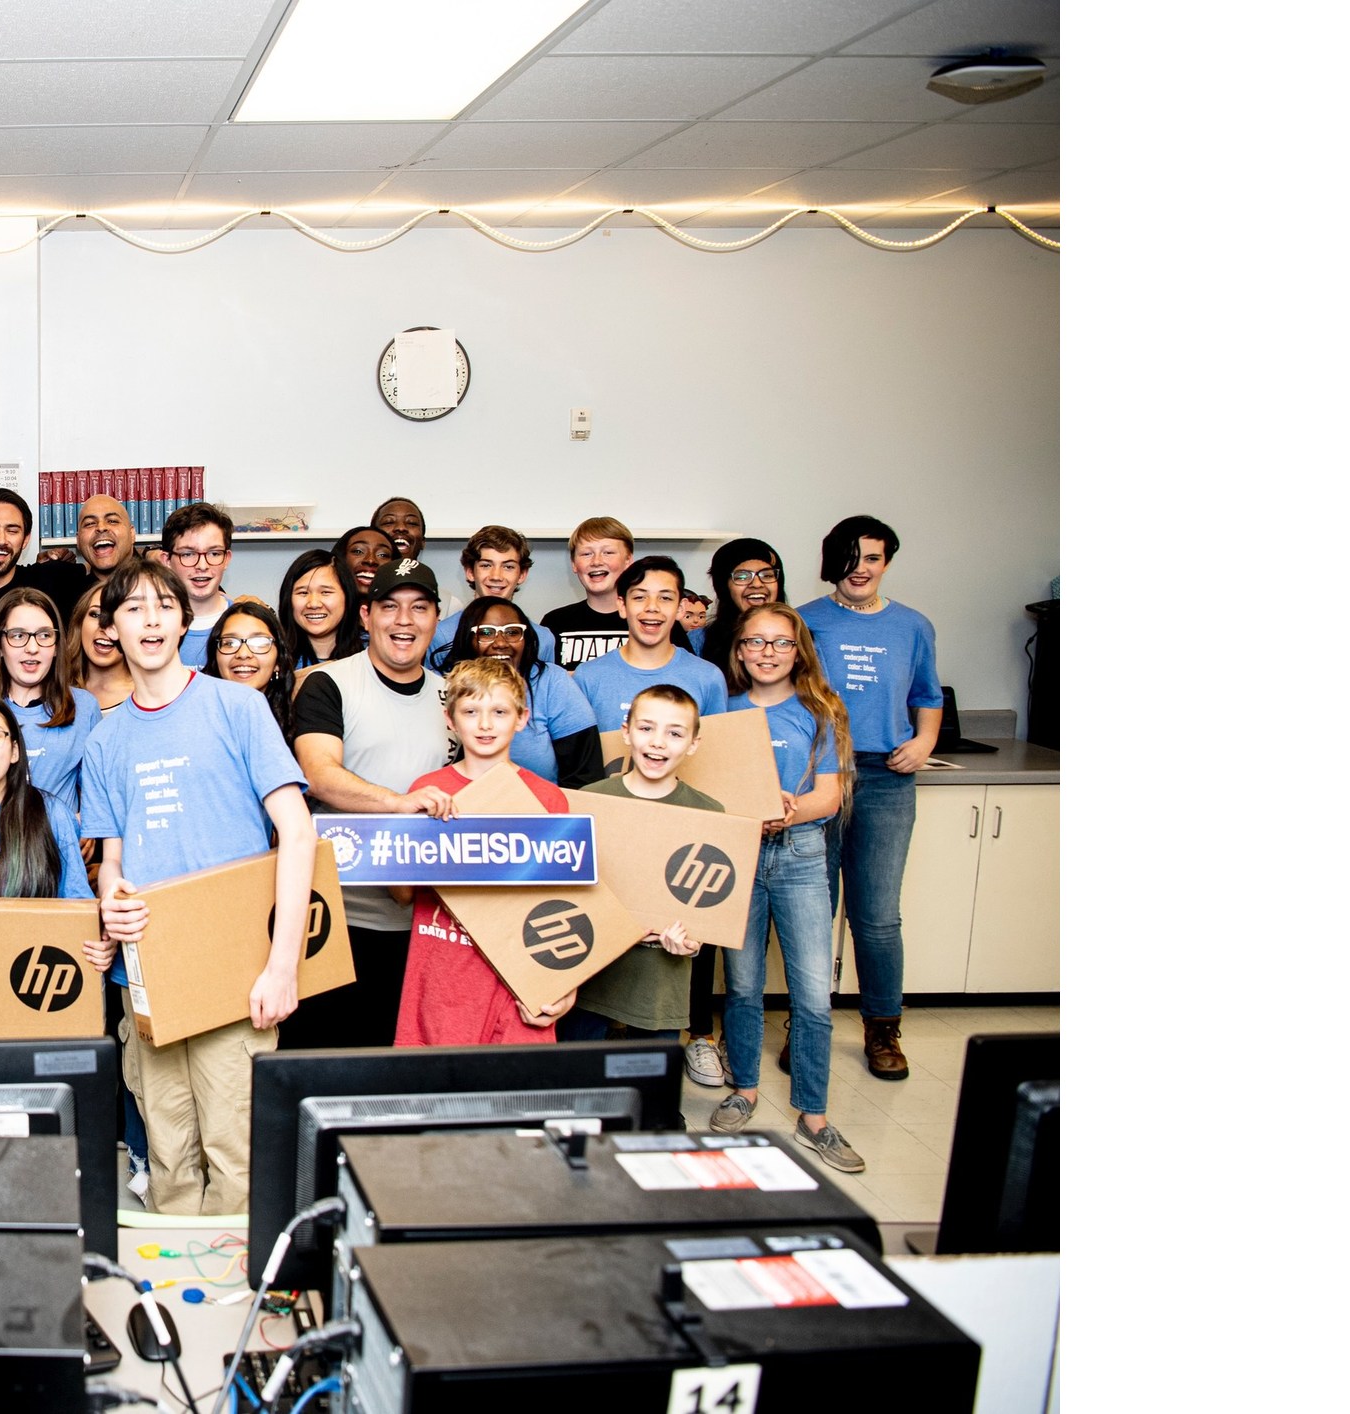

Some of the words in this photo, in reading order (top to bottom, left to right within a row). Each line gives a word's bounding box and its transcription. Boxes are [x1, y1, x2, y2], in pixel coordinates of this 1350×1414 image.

[145, 790, 163, 800] color:
[321, 825, 343, 840] ORTH
[370, 830, 586, 872] #theNEISDway
[669, 842, 732, 908] hp
[418, 924, 447, 941] DATA
[18, 946, 78, 1011] hp
[686, 1381, 743, 1414] 14
